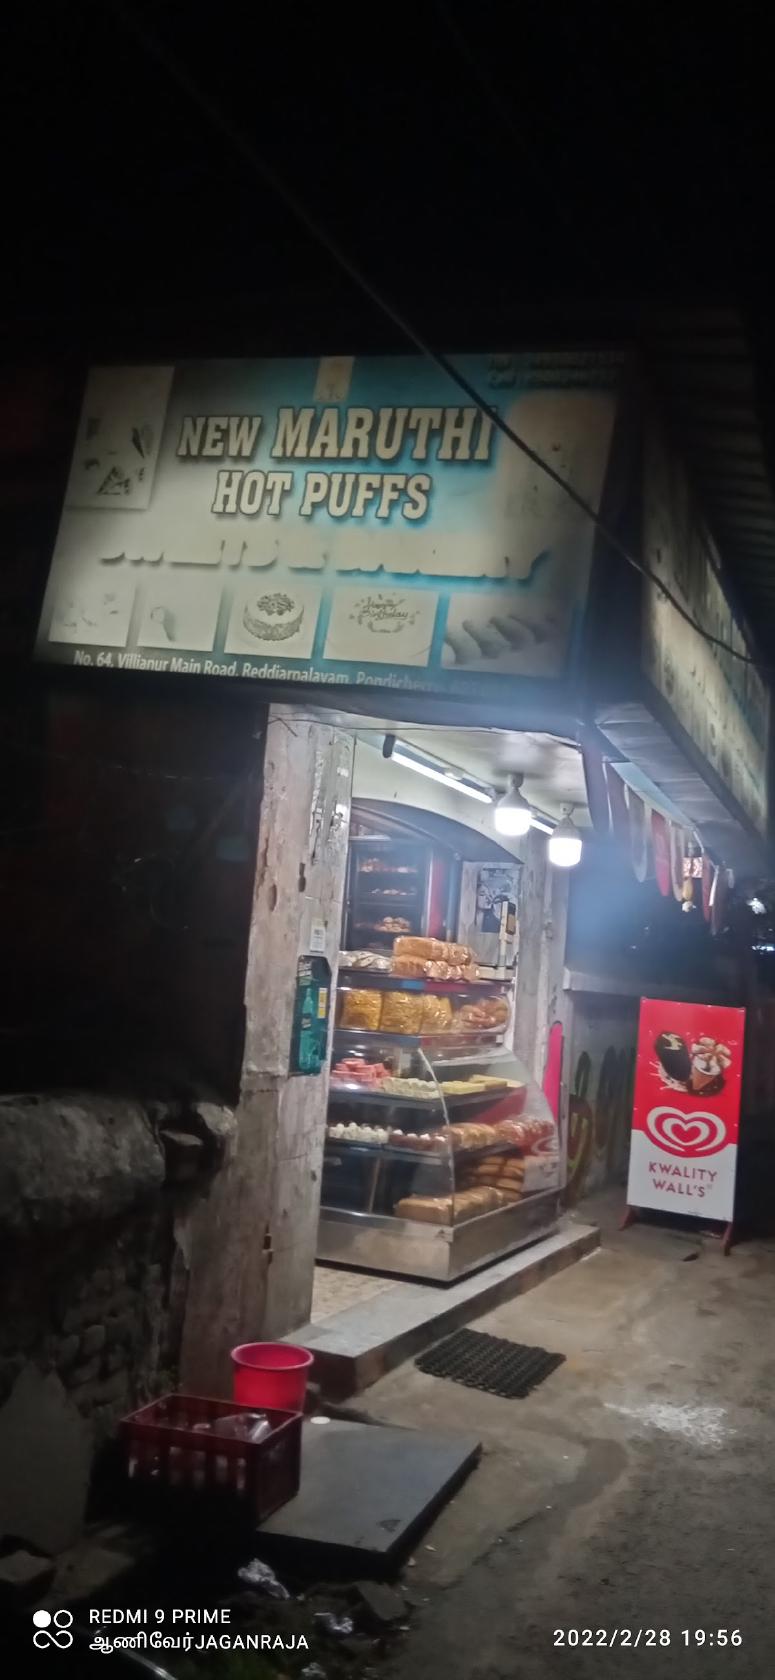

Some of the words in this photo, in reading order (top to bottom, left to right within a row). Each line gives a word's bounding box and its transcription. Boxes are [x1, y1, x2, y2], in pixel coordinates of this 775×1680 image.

[176, 416, 262, 457] NEW
[270, 406, 497, 461] MARUTHI
[211, 470, 293, 516] HOT
[299, 471, 432, 521] PUFFS
[73, 650, 94, 667] No.
[117, 653, 169, 672] Villianur
[170, 657, 200, 674] Main
[648, 1161, 718, 1182] KWALITY
[653, 1178, 706, 1198] WALL'S
